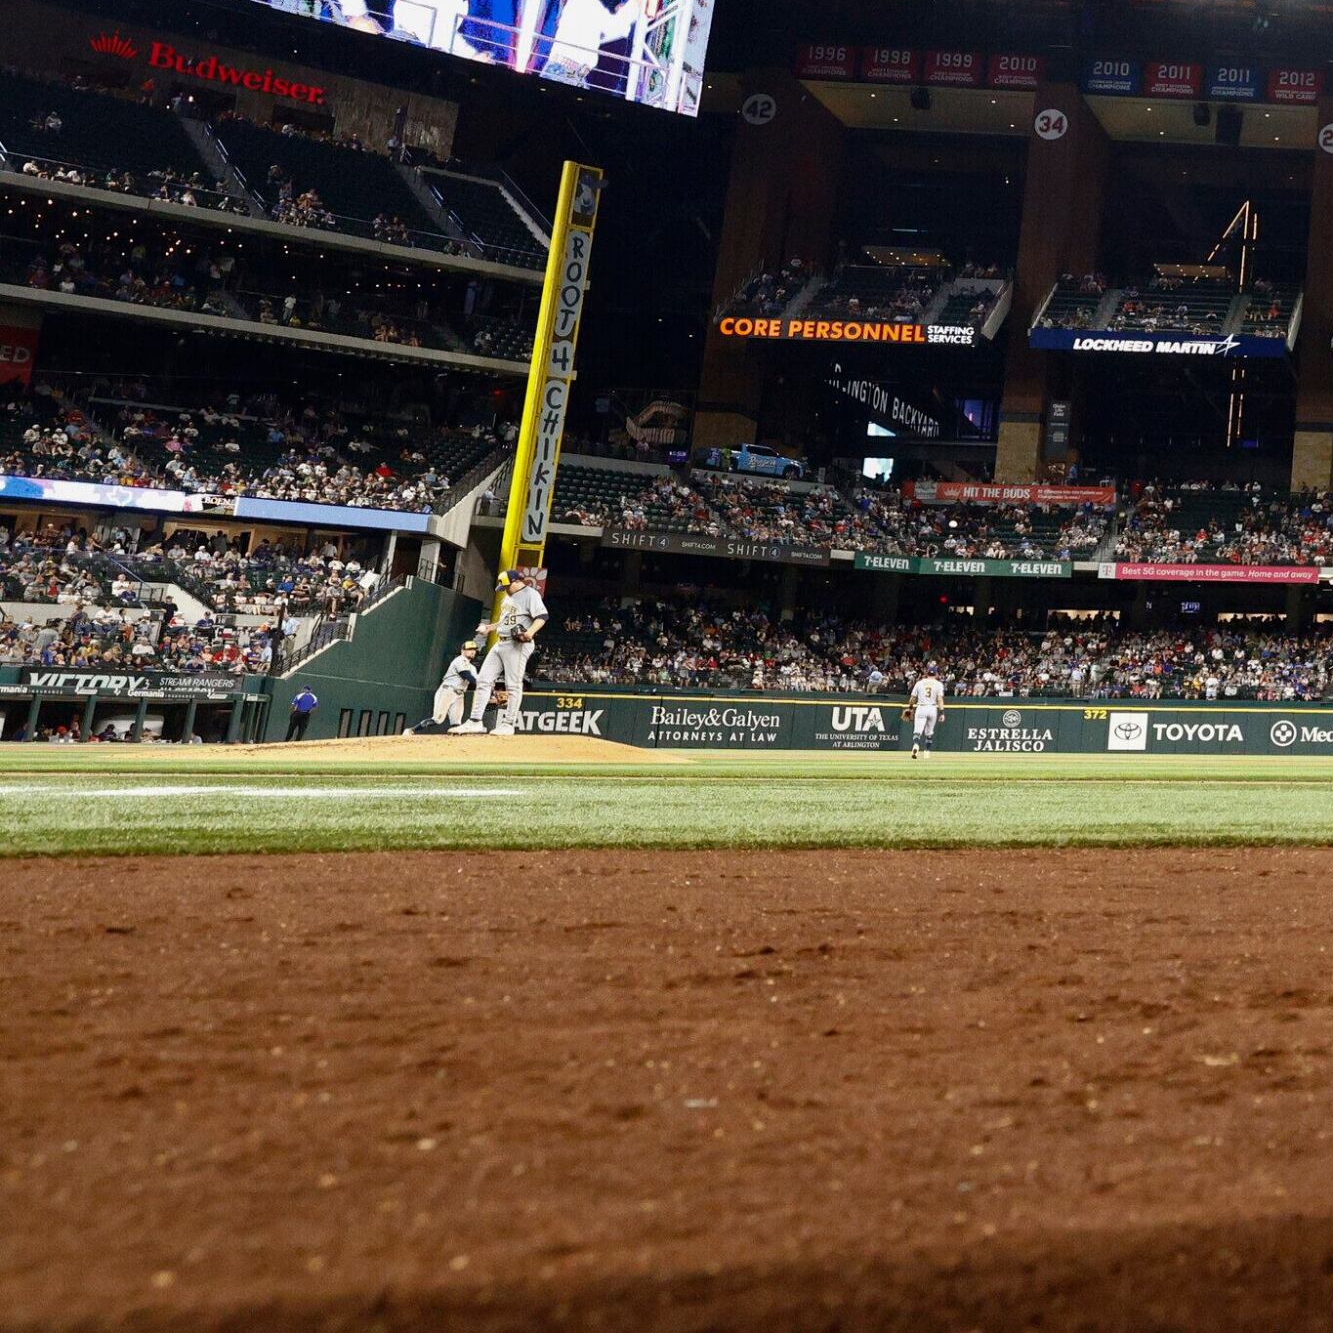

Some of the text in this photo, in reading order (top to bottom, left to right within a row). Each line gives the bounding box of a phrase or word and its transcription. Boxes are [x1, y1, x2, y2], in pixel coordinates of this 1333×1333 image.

[808, 46, 847, 61] 1996
[873, 49, 912, 65] 1998
[935, 53, 973, 68] 1999
[999, 56, 1037, 72] 2010
[1092, 61, 1130, 76] 2010
[1157, 64, 1191, 80] 2011
[1217, 67, 1250, 82] 2011
[1279, 70, 1315, 86] 2012
[747, 100, 772, 119] 42
[1038, 115, 1065, 135] 34
[560, 236, 584, 331] ROOT
[720, 317, 926, 343] CORE PERSONNEL
[927, 325, 974, 336] STAFFING
[927, 334, 973, 345] SERVICES
[1073, 338, 1216, 355] LOCKHEED MARTIN
[528, 386, 563, 535] CHIKIN
[963, 486, 981, 498] HIT
[982, 487, 1001, 499] THE
[1003, 488, 1031, 500] BUDS
[611, 532, 655, 547] SHIFT
[727, 543, 768, 557] SHIFT
[1122, 567, 1141, 575] Best
[1156, 569, 1195, 578] coverage
[1205, 568, 1218, 577] the
[1219, 570, 1246, 579] game.
[1247, 568, 1272, 578] Home
[1273, 570, 1289, 578] and
[1290, 571, 1313, 580] away
[503, 615, 517, 626] 39
[29, 672, 144, 691] VICTORY
[159, 677, 235, 689] STREAM RANGERS
[127, 689, 165, 698] Germania
[557, 697, 583, 709] 334
[650, 706, 780, 733] Bailey&Galyen
[832, 706, 885, 732] UTA
[1084, 709, 1107, 720] 372
[648, 732, 778, 742] ATTORNEYS AT LAW
[968, 728, 1053, 740] ESTRELLA
[1153, 723, 1244, 742] TOYOTA
[974, 740, 1045, 752] JALISCO
